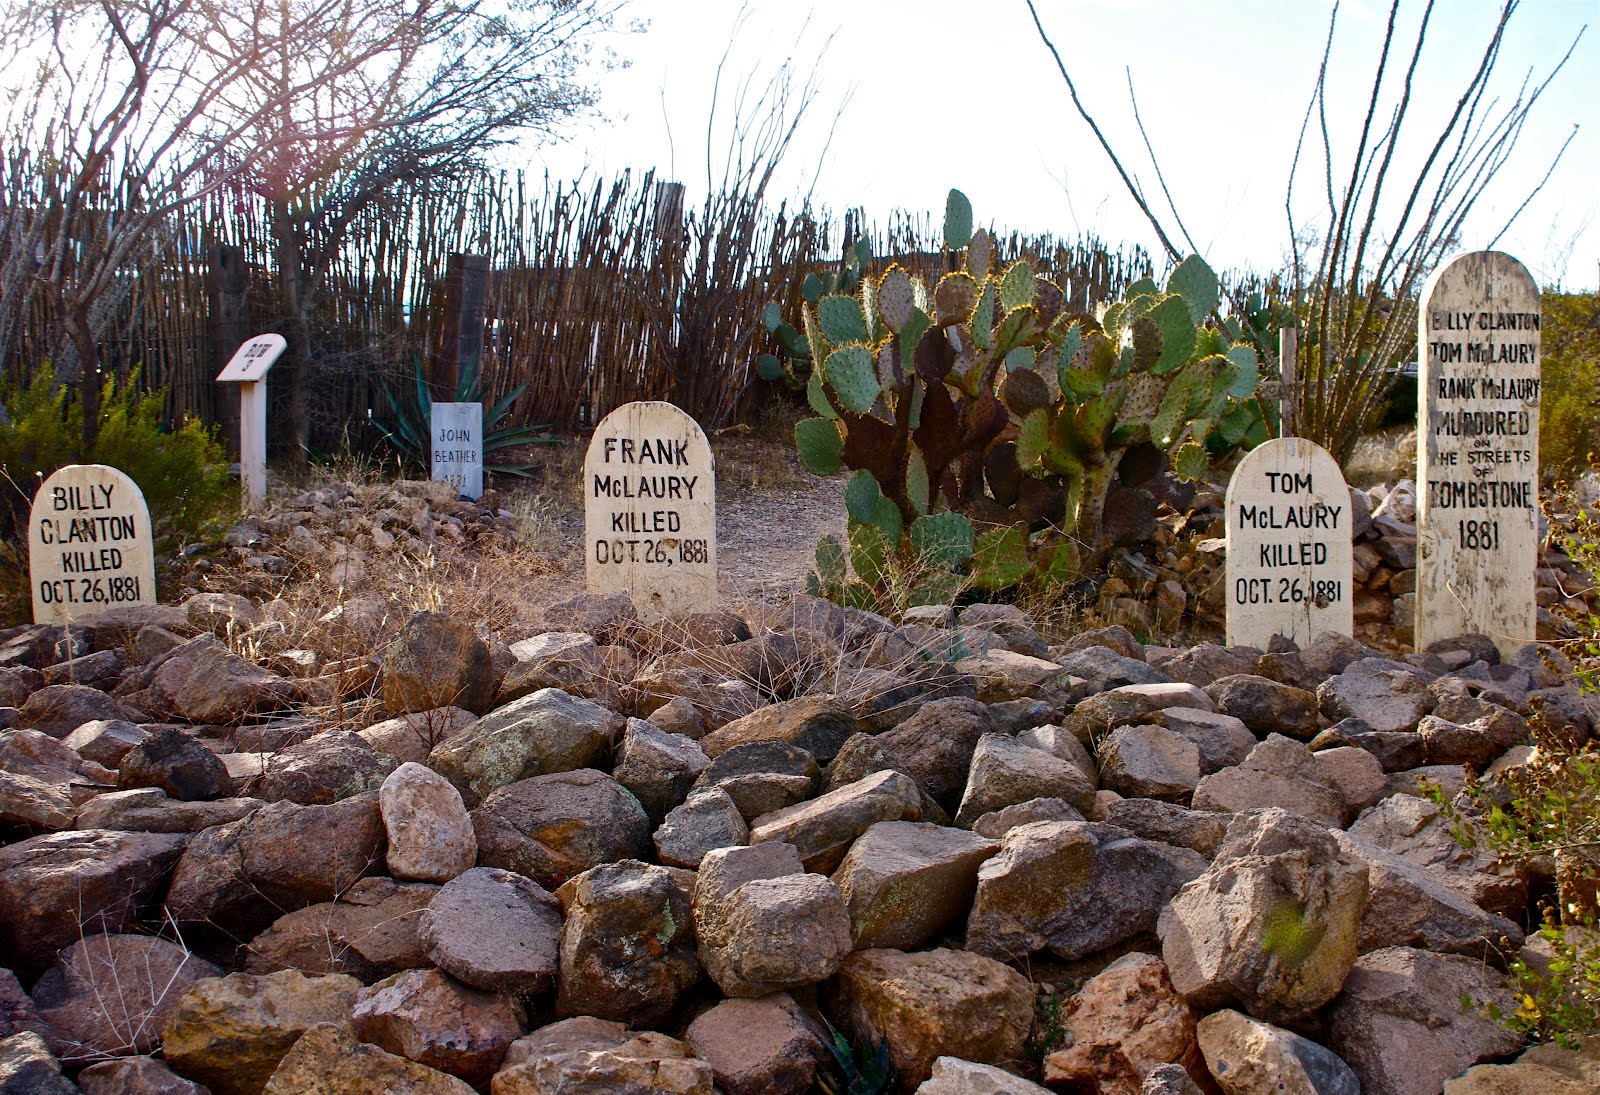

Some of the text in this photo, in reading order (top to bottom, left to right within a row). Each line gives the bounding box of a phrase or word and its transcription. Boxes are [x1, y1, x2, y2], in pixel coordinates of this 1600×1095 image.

[1432, 312, 1540, 331] BLLY CLANTON
[1430, 342, 1536, 363] TOM McLAURY
[1438, 377, 1540, 399] RANK McLAURY
[440, 428, 470, 443] JOHN
[1473, 439, 1491, 448] ON
[434, 450, 477, 464] BEATHER
[604, 437, 689, 466] FRANK
[1440, 450, 1531, 466] HE STREETS
[1265, 472, 1313, 494] TOM
[1475, 468, 1490, 478] OF
[53, 484, 114, 511] BILLY
[594, 474, 698, 500] McLAURY
[1428, 480, 1533, 509] TOMBSTONE
[611, 511, 681, 533] KILLED
[1239, 504, 1342, 529] McLAURY
[41, 514, 136, 545] CLANTON
[1459, 519, 1499, 551] 1881
[62, 548, 123, 573] KILLED
[1260, 542, 1327, 567] KILLED
[1236, 578, 1273, 604] OCT.
